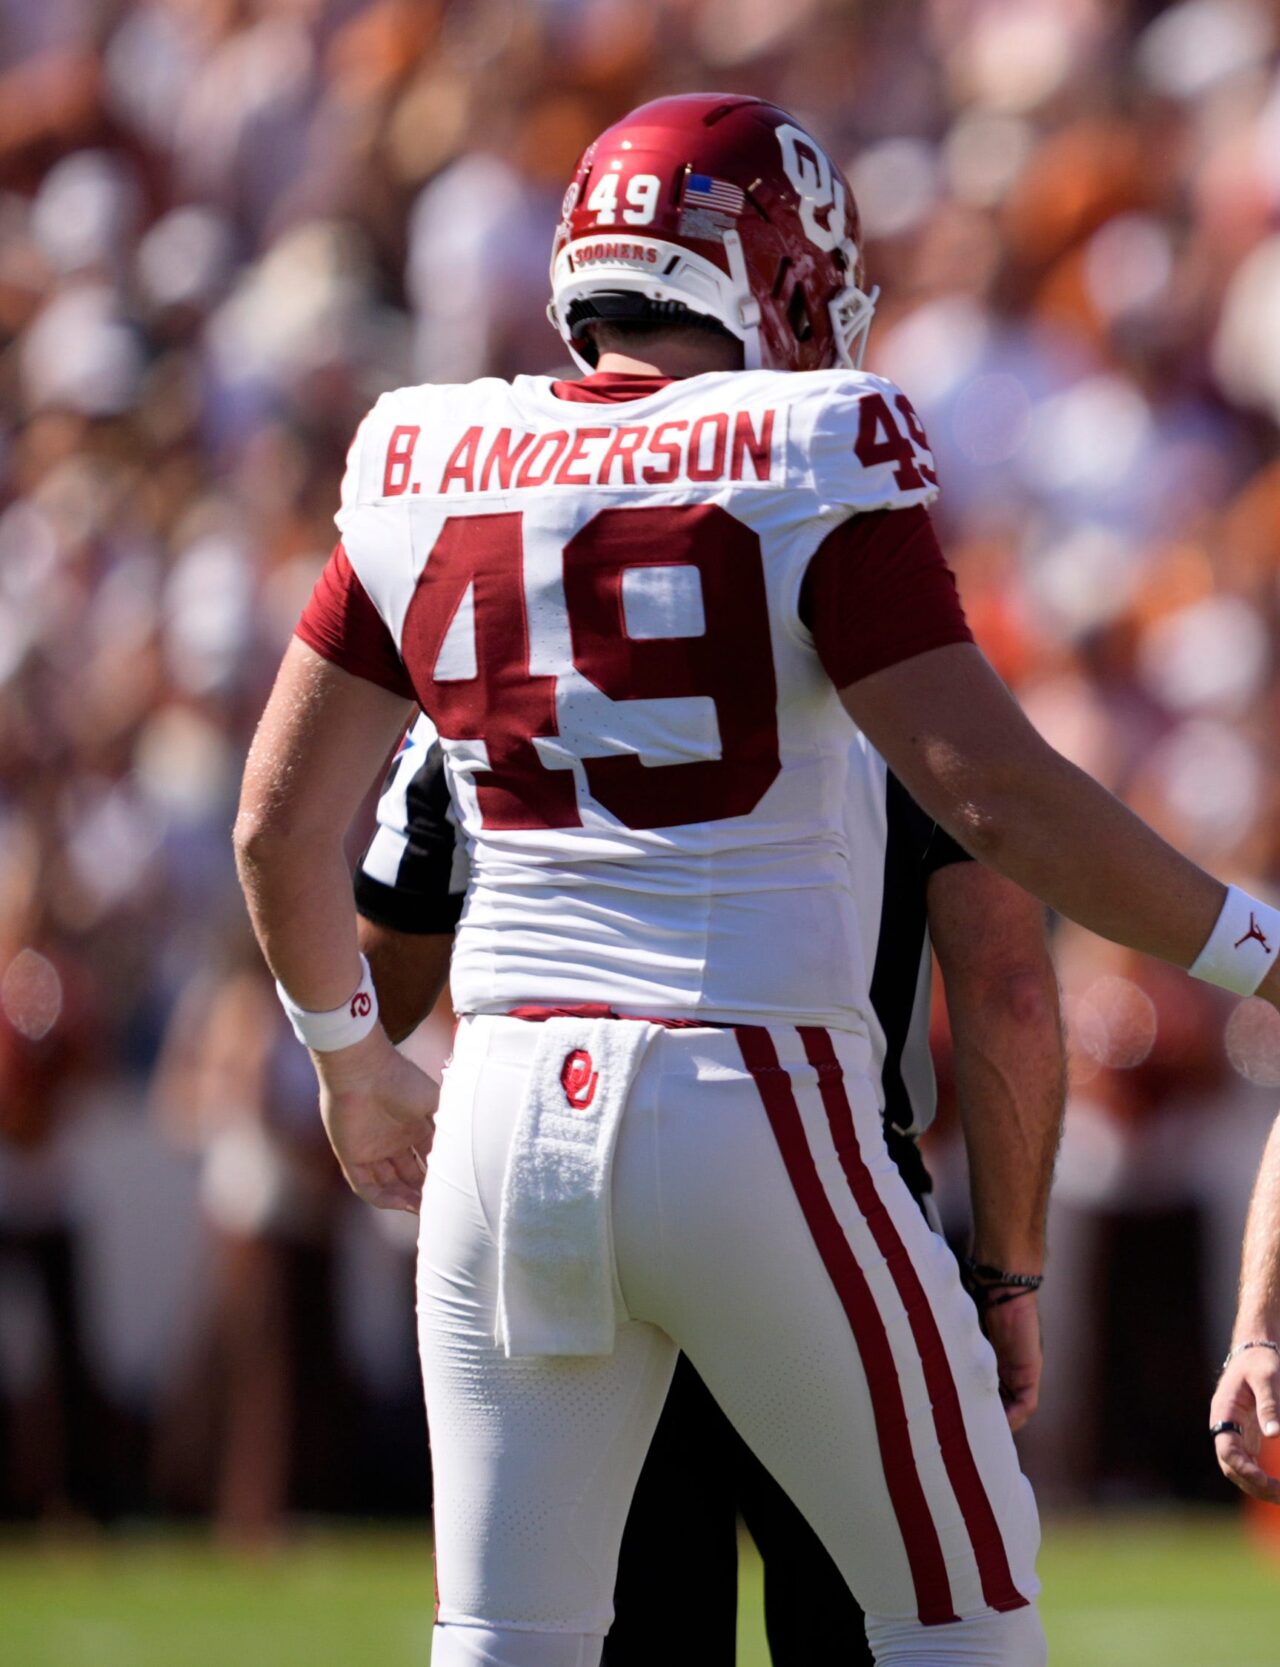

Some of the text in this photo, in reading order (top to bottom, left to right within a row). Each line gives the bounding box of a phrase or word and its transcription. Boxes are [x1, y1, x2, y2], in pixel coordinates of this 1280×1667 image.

[587, 173, 661, 226] 49
[574, 242, 658, 264] SOONERS
[382, 409, 776, 498] B. ANDERSON
[401, 503, 782, 831] 49
[560, 1049, 599, 1110] OU
